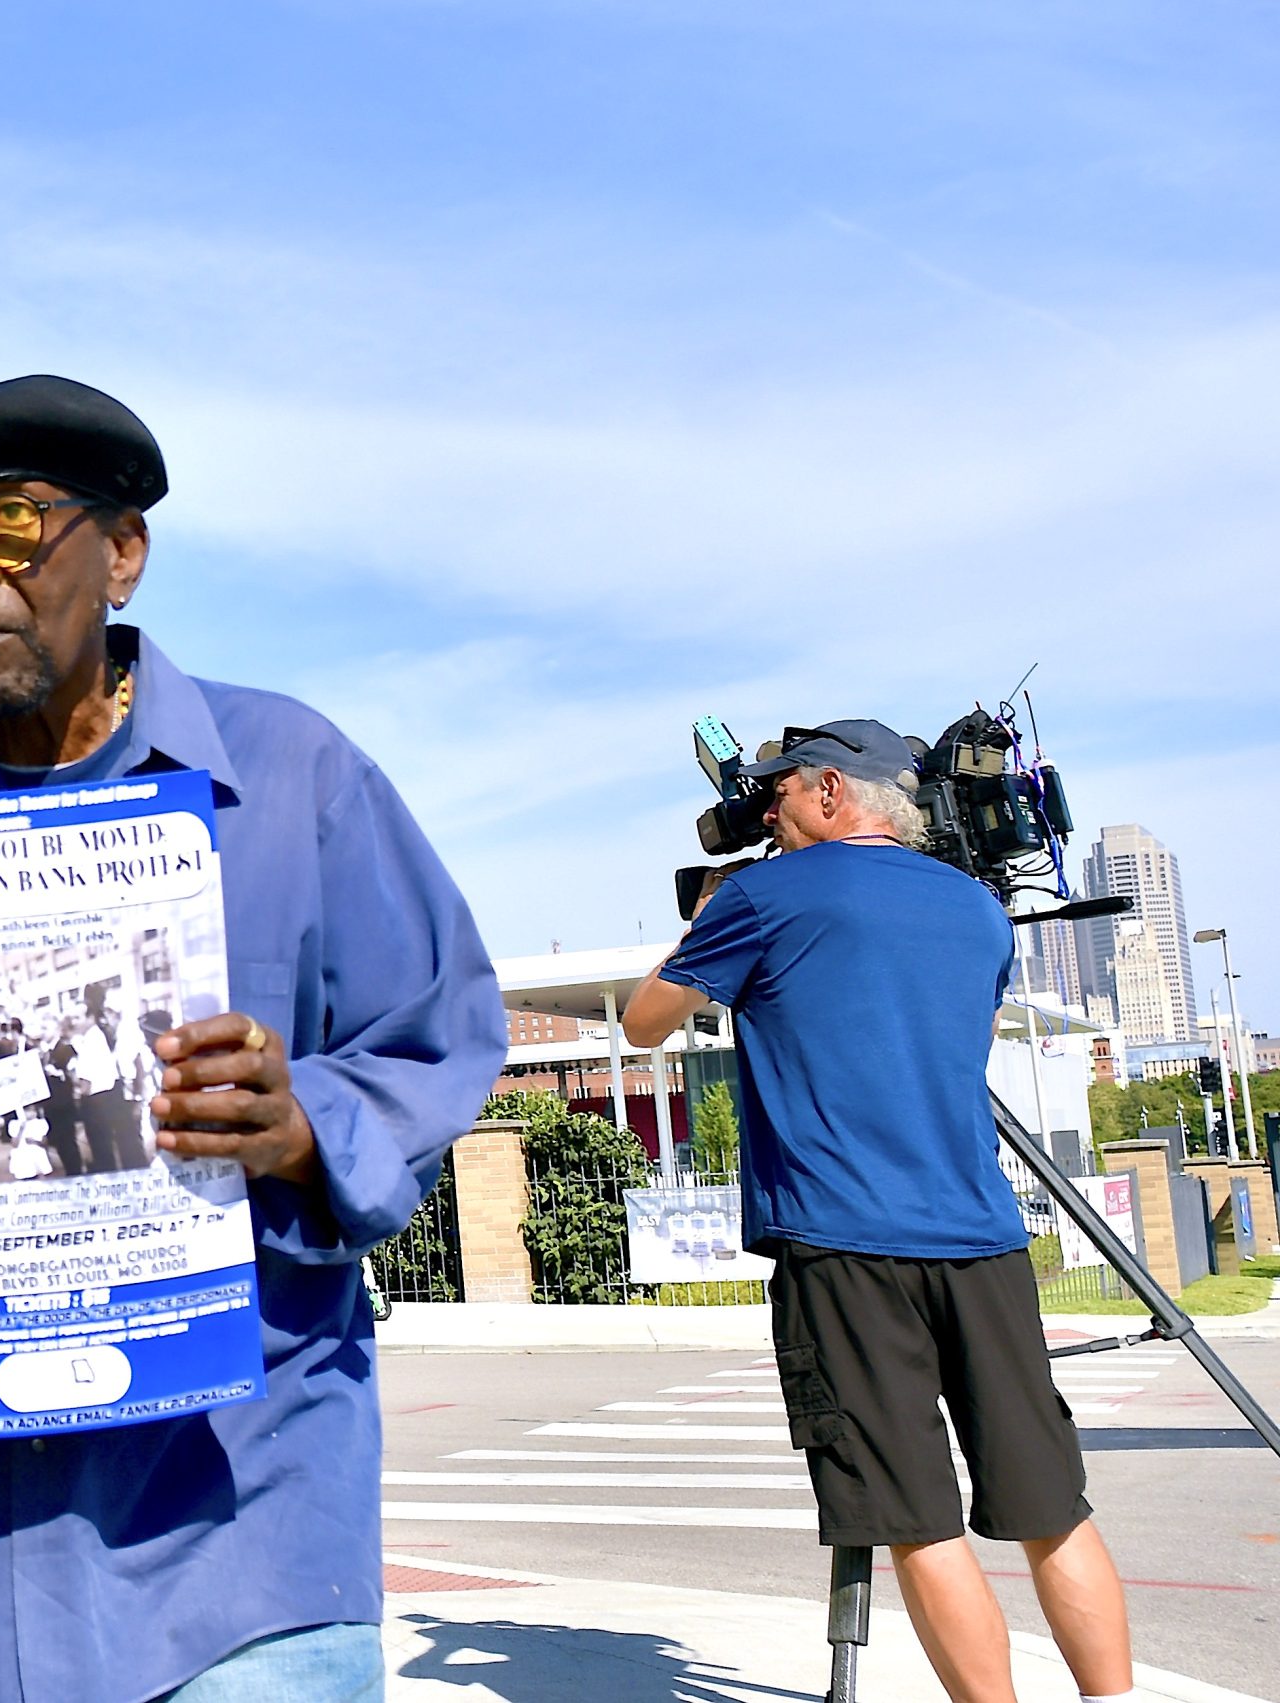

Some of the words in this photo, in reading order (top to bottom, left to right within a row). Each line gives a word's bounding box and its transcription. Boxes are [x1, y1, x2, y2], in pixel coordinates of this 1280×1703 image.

[42, 834, 62, 856] BE
[19, 866, 86, 891] BANK
[97, 850, 201, 885] PROTEST
[11, 1208, 84, 1230] Congressman
[89, 1201, 131, 1218] William
[116, 1221, 163, 1241] 2024
[169, 1220, 184, 1232] AT
[191, 1214, 200, 1229] 7
[206, 1212, 225, 1224] PM
[126, 1243, 186, 1262] CHURCH
[2, 1277, 39, 1290] BLVD
[47, 1273, 62, 1287] ST
[118, 1264, 142, 1278] MO
[6, 1317, 17, 1326] AT
[22, 1315, 39, 1325] THE
[75, 1310, 90, 1321] ON
[94, 1307, 111, 1319] THE
[114, 1304, 135, 1316] DAY
[138, 1301, 151, 1313] OF
[155, 1298, 172, 1309] THE
[176, 1284, 248, 1306] PERFORMANCE
[3, 1419, 14, 1430] IN
[18, 1414, 72, 1428] ADVANCE
